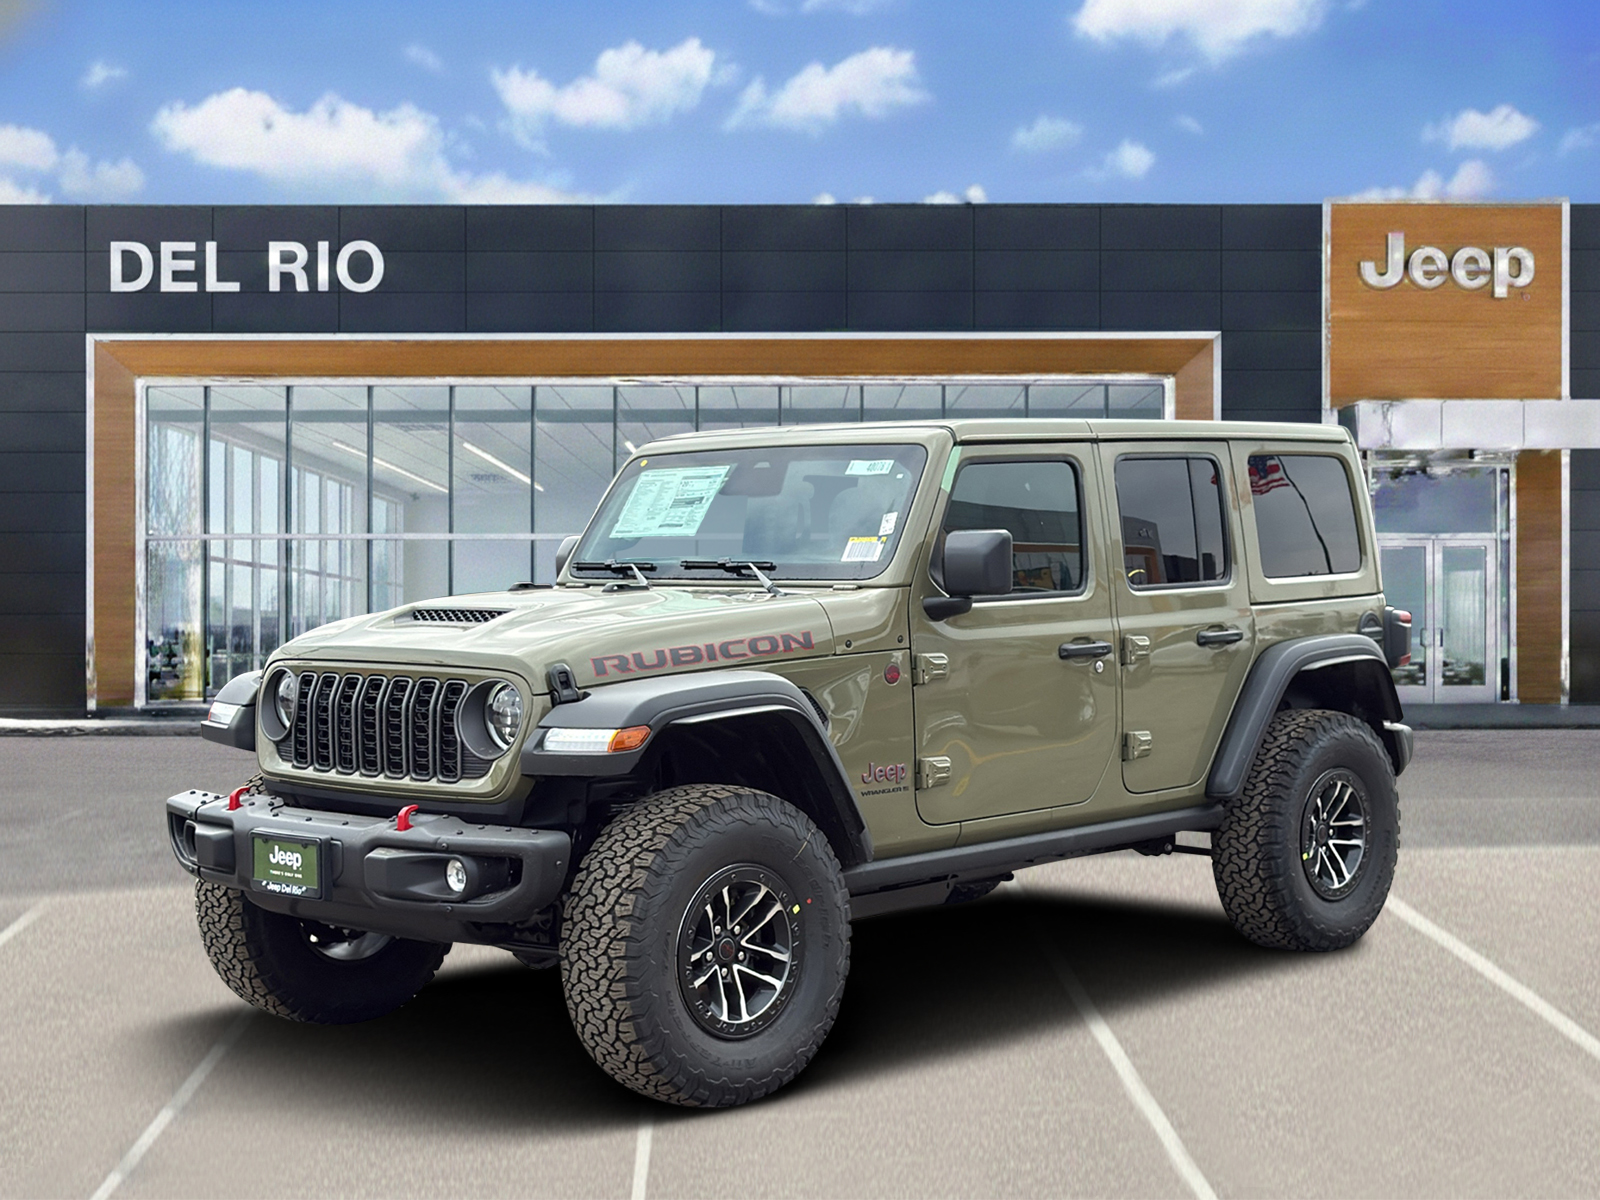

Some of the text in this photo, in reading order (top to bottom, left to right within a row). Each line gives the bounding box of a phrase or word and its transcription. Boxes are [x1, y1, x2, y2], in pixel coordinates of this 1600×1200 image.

[110, 240, 385, 293] DEL RIO
[1360, 231, 1535, 298] Jeep
[590, 631, 815, 677] RUBICON
[861, 762, 906, 784] Jeep
[861, 786, 902, 797] WRANGLER
[269, 844, 302, 870] Jeep
